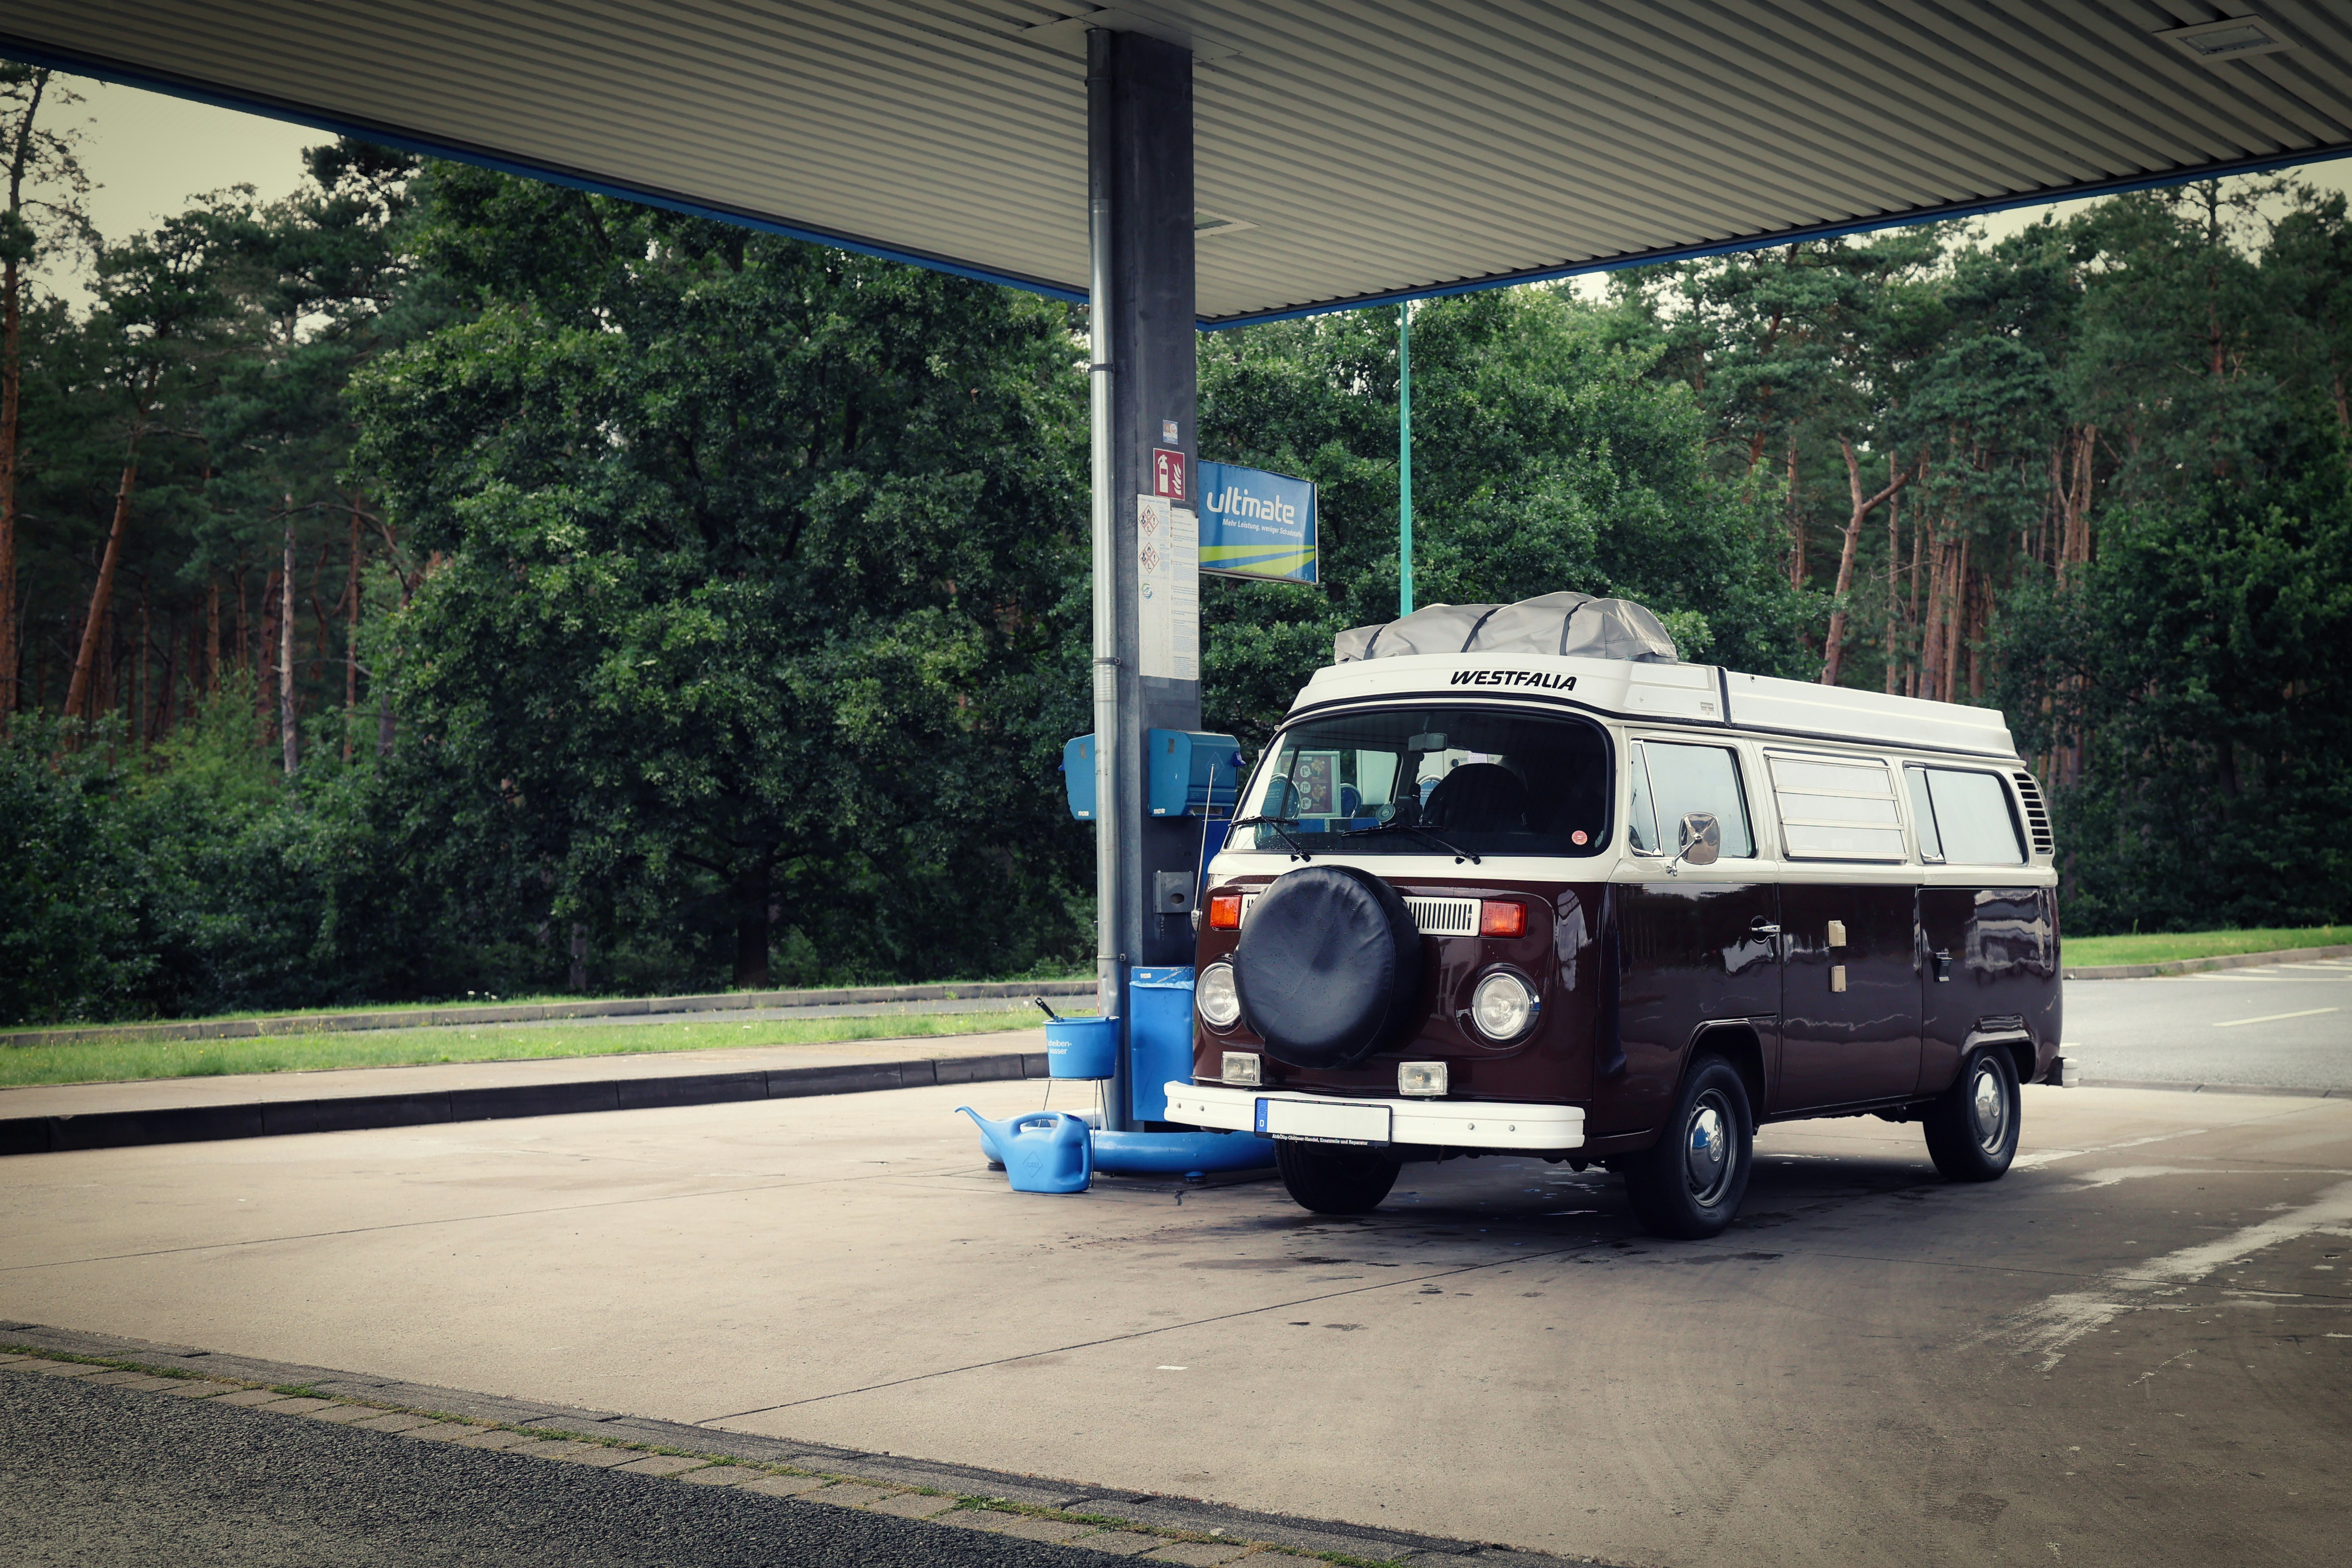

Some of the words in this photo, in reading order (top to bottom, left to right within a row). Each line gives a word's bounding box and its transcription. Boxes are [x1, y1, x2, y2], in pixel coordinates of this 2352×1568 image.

[1207, 486, 1295, 524] ultimate
[1222, 518, 1236, 527] Mehr
[1238, 520, 1260, 531] Leistung,
[1261, 525, 1279, 534] weniger
[1280, 527, 1302, 538] Schadstoffe
[1451, 670, 1577, 691] WESTFALIA
